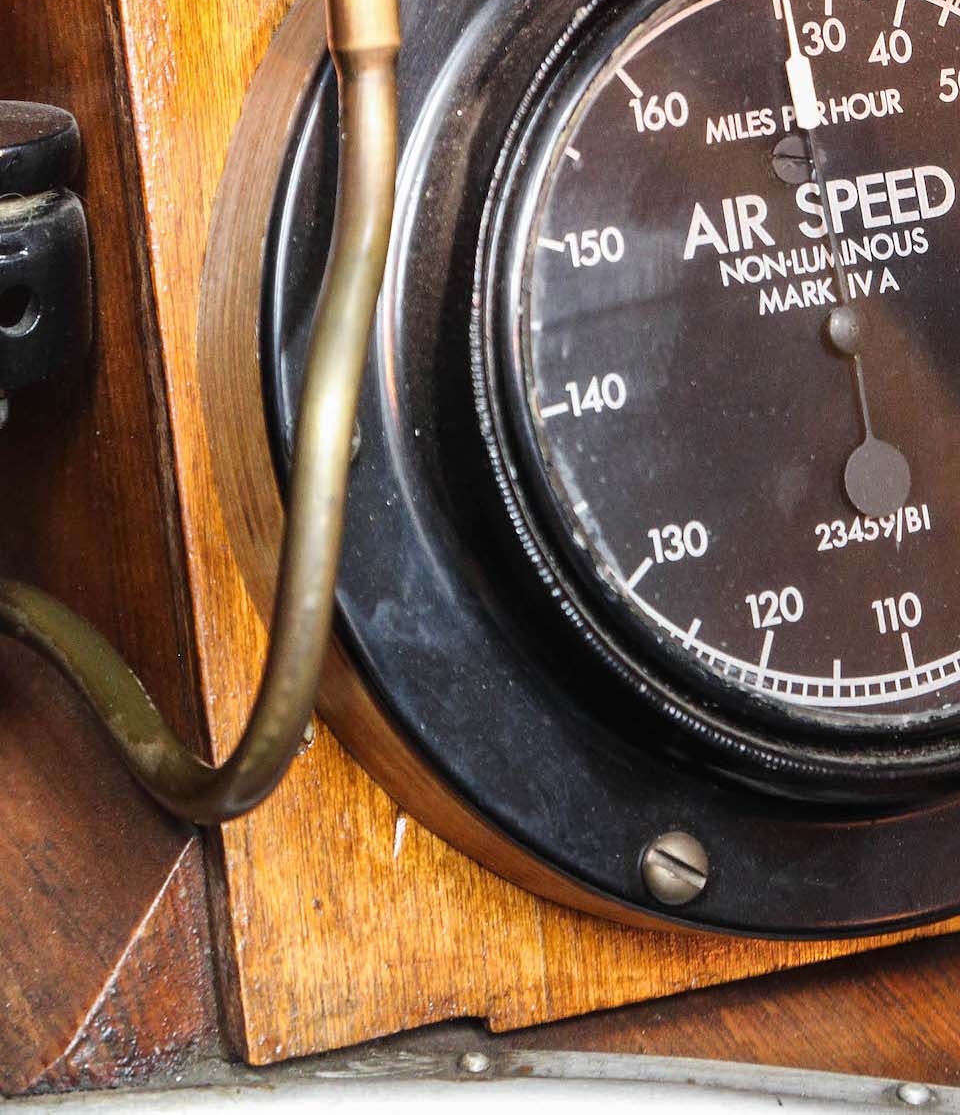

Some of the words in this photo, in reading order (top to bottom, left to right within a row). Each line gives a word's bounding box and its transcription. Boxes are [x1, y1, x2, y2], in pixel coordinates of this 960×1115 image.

[803, 17, 846, 57] 30
[867, 29, 914, 66] 40
[628, 92, 689, 133] 160
[705, 108, 777, 145] MILES
[782, 102, 828, 132] PR
[830, 88, 904, 124] HOUR
[683, 194, 776, 261] AIR
[795, 165, 956, 239] SPEED
[566, 227, 625, 264] 150
[759, 277, 837, 316] MARK
[566, 374, 627, 413] 140
[648, 521, 709, 564] 130
[745, 586, 804, 630] 120
[871, 591, 922, 634] 110
